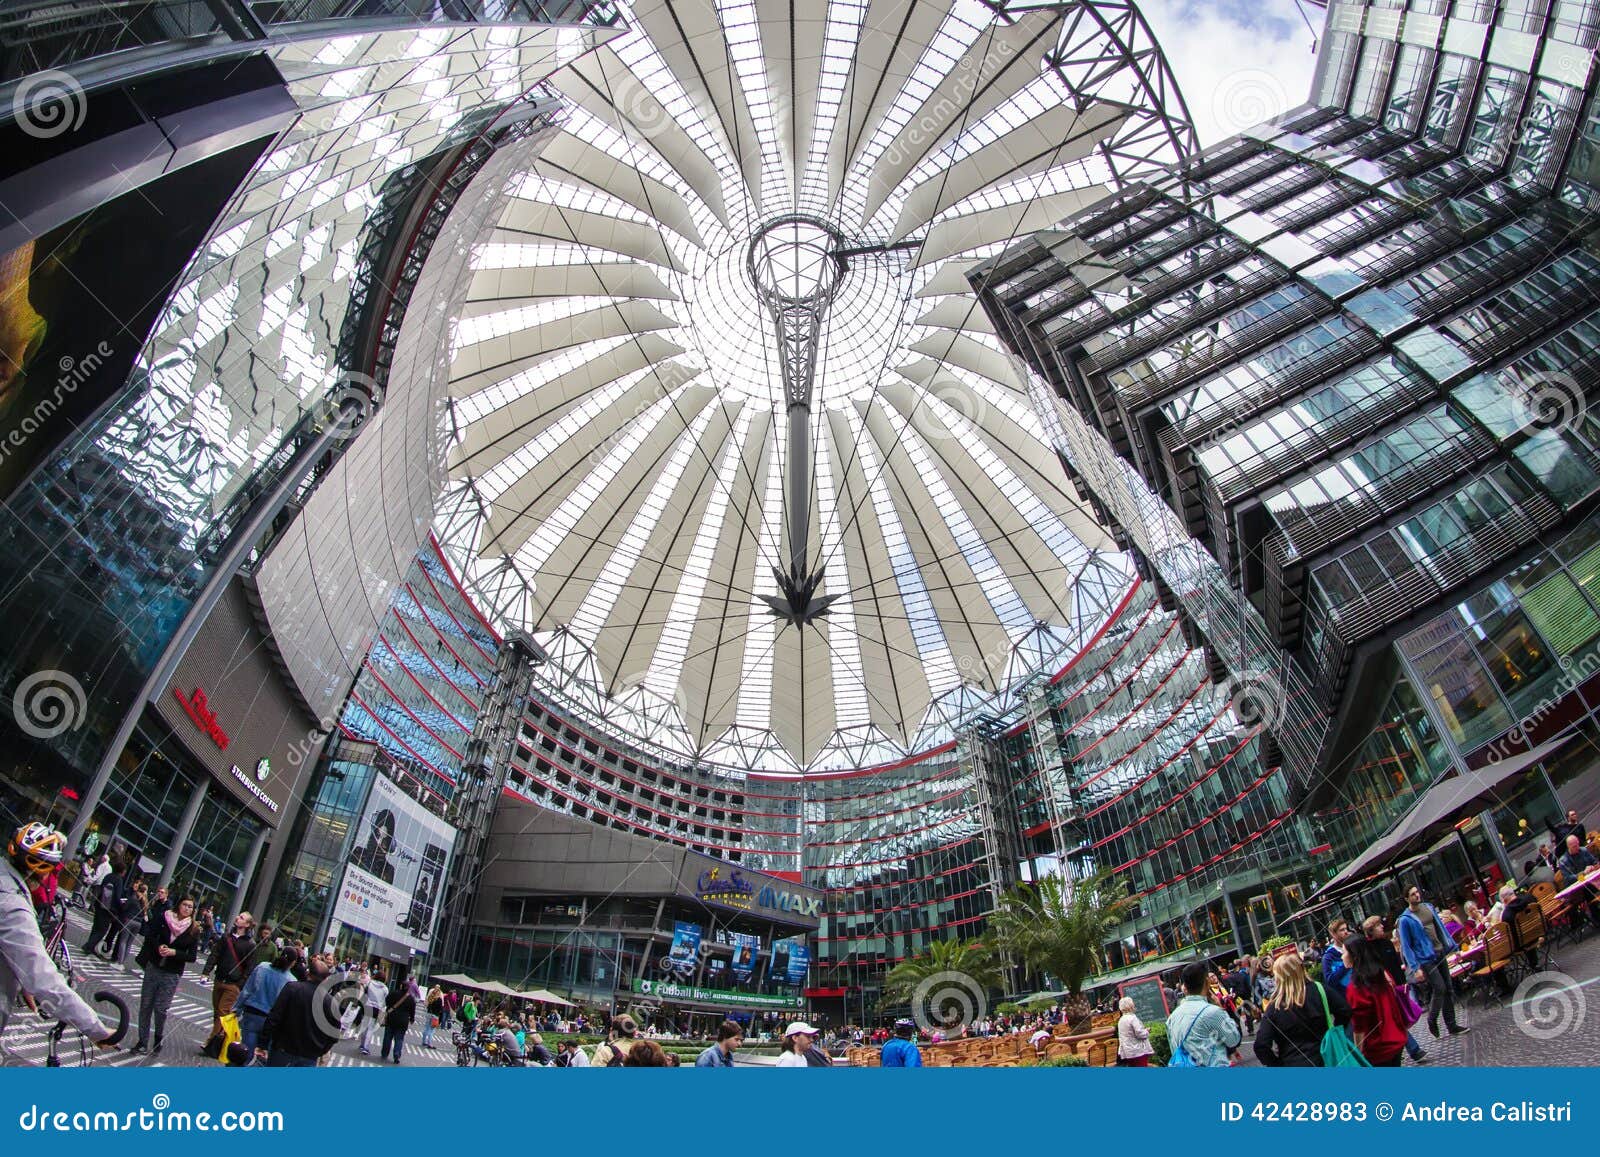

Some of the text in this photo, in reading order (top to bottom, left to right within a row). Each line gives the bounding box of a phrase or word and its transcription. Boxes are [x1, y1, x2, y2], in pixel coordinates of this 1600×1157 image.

[231, 764, 279, 813] STARBUCKS COFFEE
[759, 884, 820, 918] IMAX
[656, 983, 692, 998] Fußball
[693, 987, 712, 1000] live!
